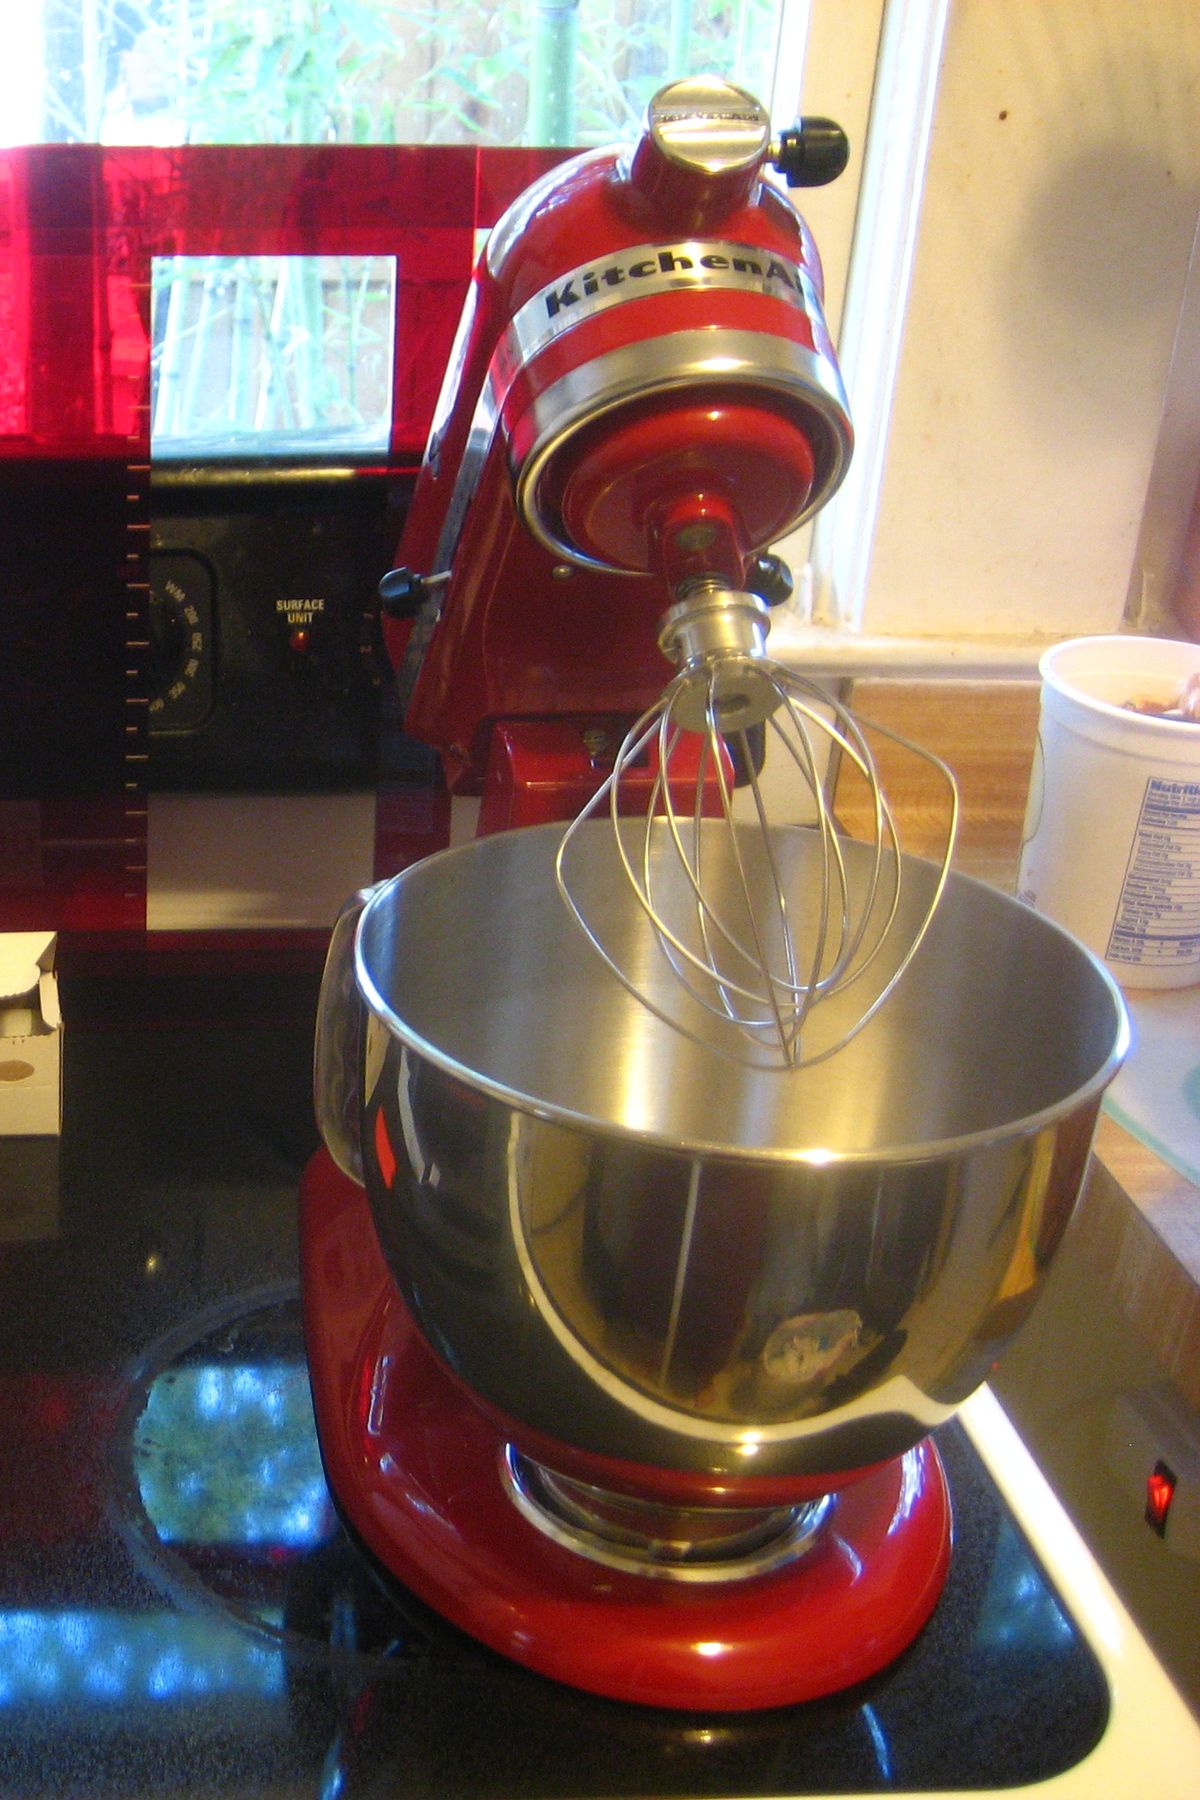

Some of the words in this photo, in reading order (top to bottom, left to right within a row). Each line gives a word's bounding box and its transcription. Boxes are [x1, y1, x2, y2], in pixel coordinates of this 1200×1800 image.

[276, 598, 325, 611] SURFACE
[287, 612, 313, 624] UNIT
[191, 631, 203, 653] 250
